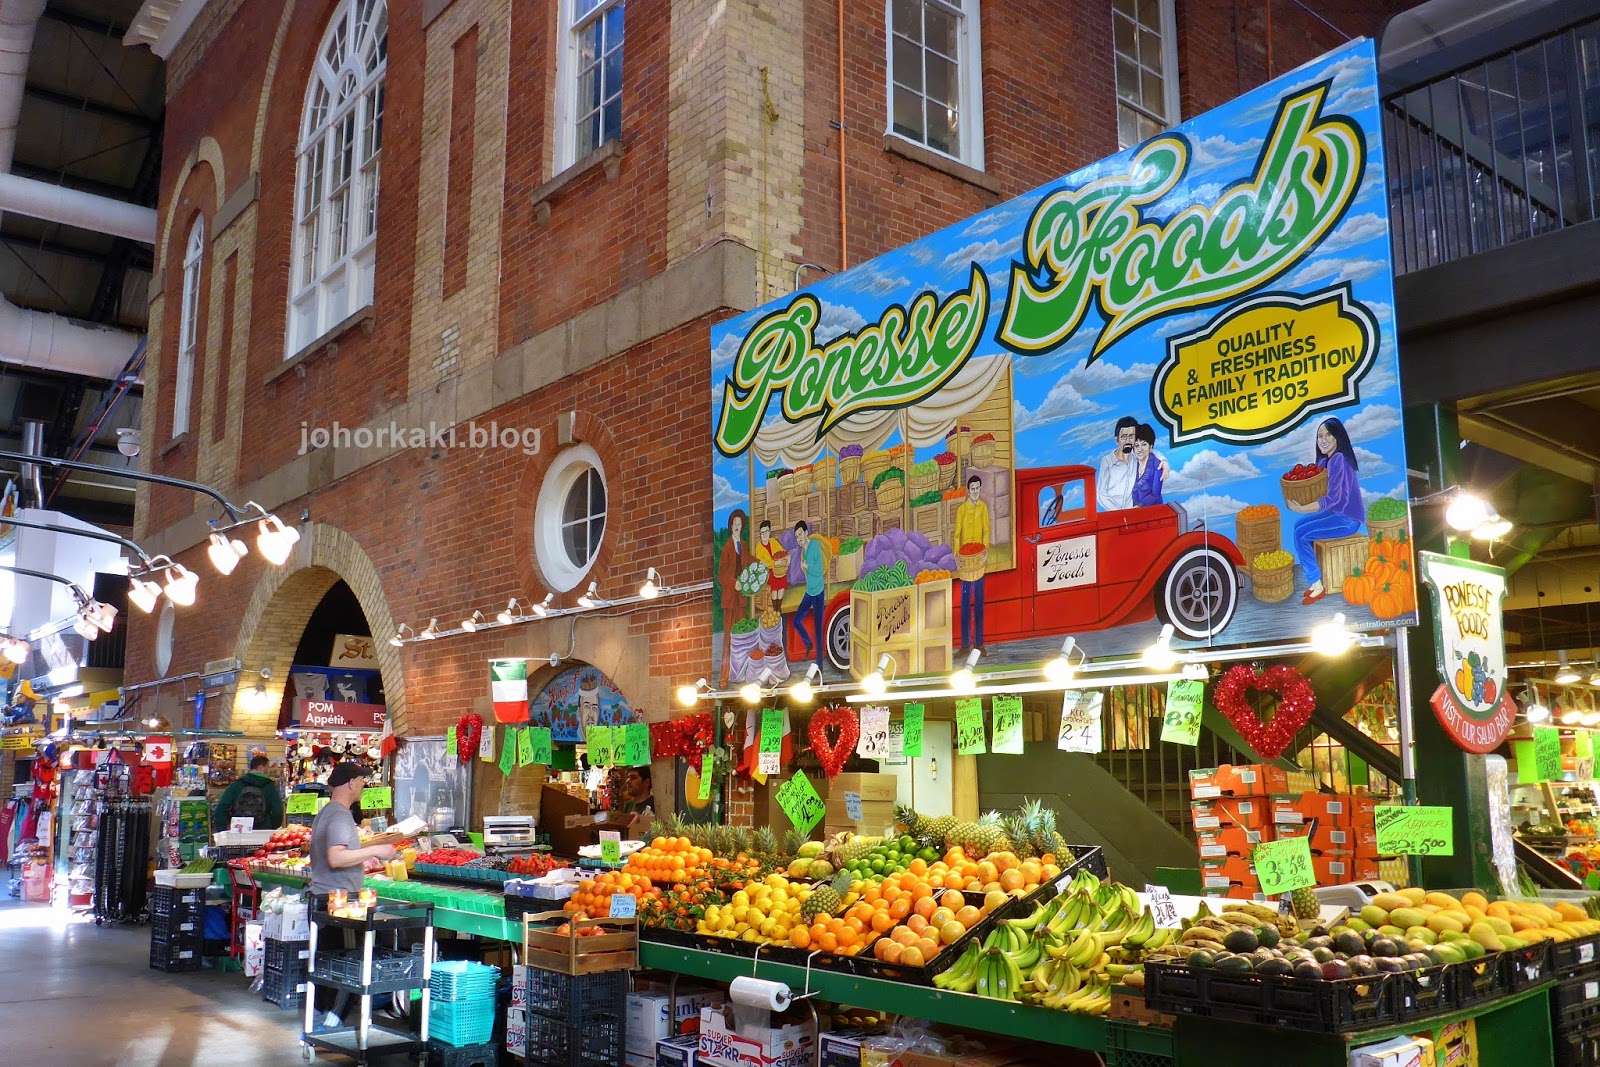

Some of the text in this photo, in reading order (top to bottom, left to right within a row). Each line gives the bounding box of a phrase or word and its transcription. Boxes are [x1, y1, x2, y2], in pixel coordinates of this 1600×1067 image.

[714, 77, 1366, 458] Ponesse Foods
[1217, 320, 1295, 357] QUALITY
[1171, 345, 1356, 409] A FAMILY TRADITION
[1186, 335, 1317, 386] & FRESHNESS
[1208, 379, 1309, 420] SINCE 1903
[1042, 544, 1092, 567] Ponesse
[1046, 561, 1086, 583] Foods
[876, 591, 909, 631] Ponesse
[1443, 580, 1492, 616] PONESSE
[883, 606, 911, 643] Foods
[1455, 611, 1488, 640] FOODS
[339, 638, 374, 660] St.
[306, 713, 347, 726] Appétit.
[308, 702, 334, 712] POM
[1441, 691, 1511, 745] VISIT OUR SALAD BAR
[707, 1029, 732, 1046] SUPER
